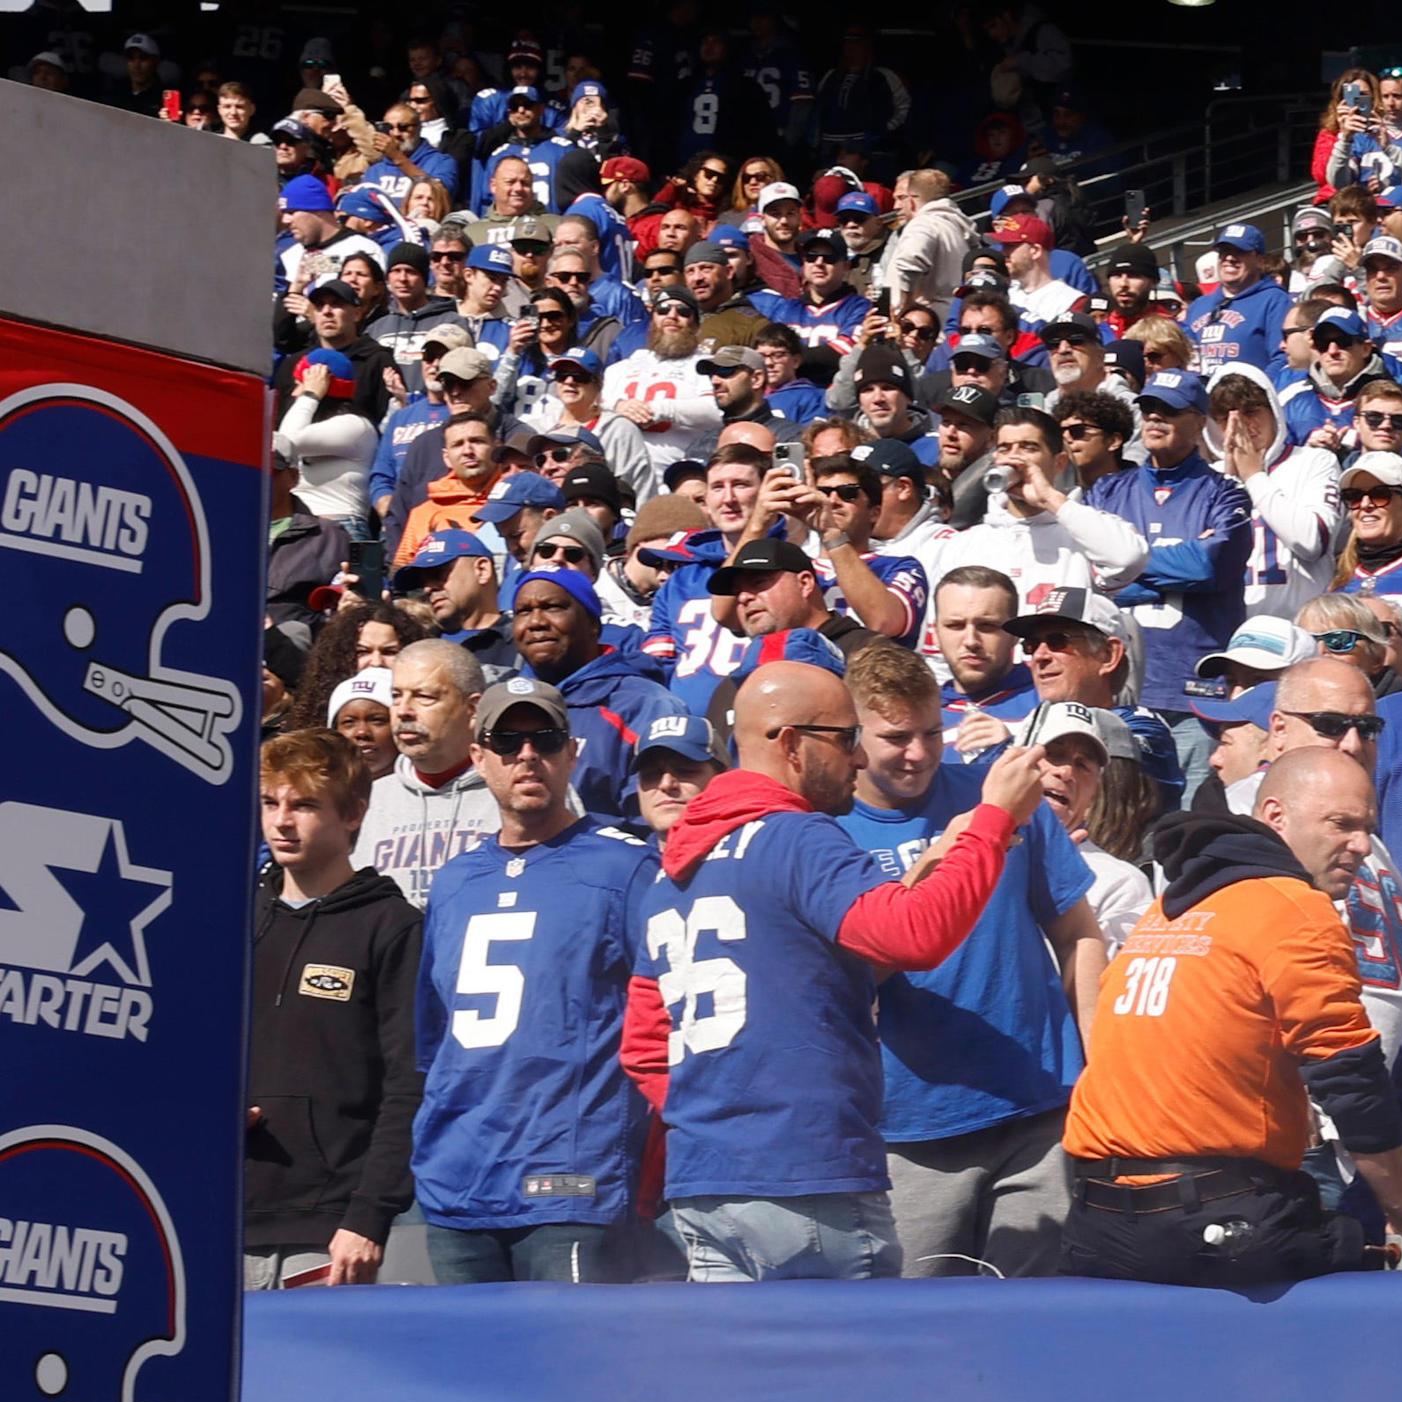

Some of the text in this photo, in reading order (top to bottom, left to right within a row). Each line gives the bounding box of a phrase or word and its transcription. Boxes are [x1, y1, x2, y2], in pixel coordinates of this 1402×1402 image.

[693, 93, 719, 134] 8
[2, 468, 153, 558] GIANTS
[648, 716, 687, 741] ny
[452, 911, 537, 1049] 5
[1114, 957, 1177, 1016] 318
